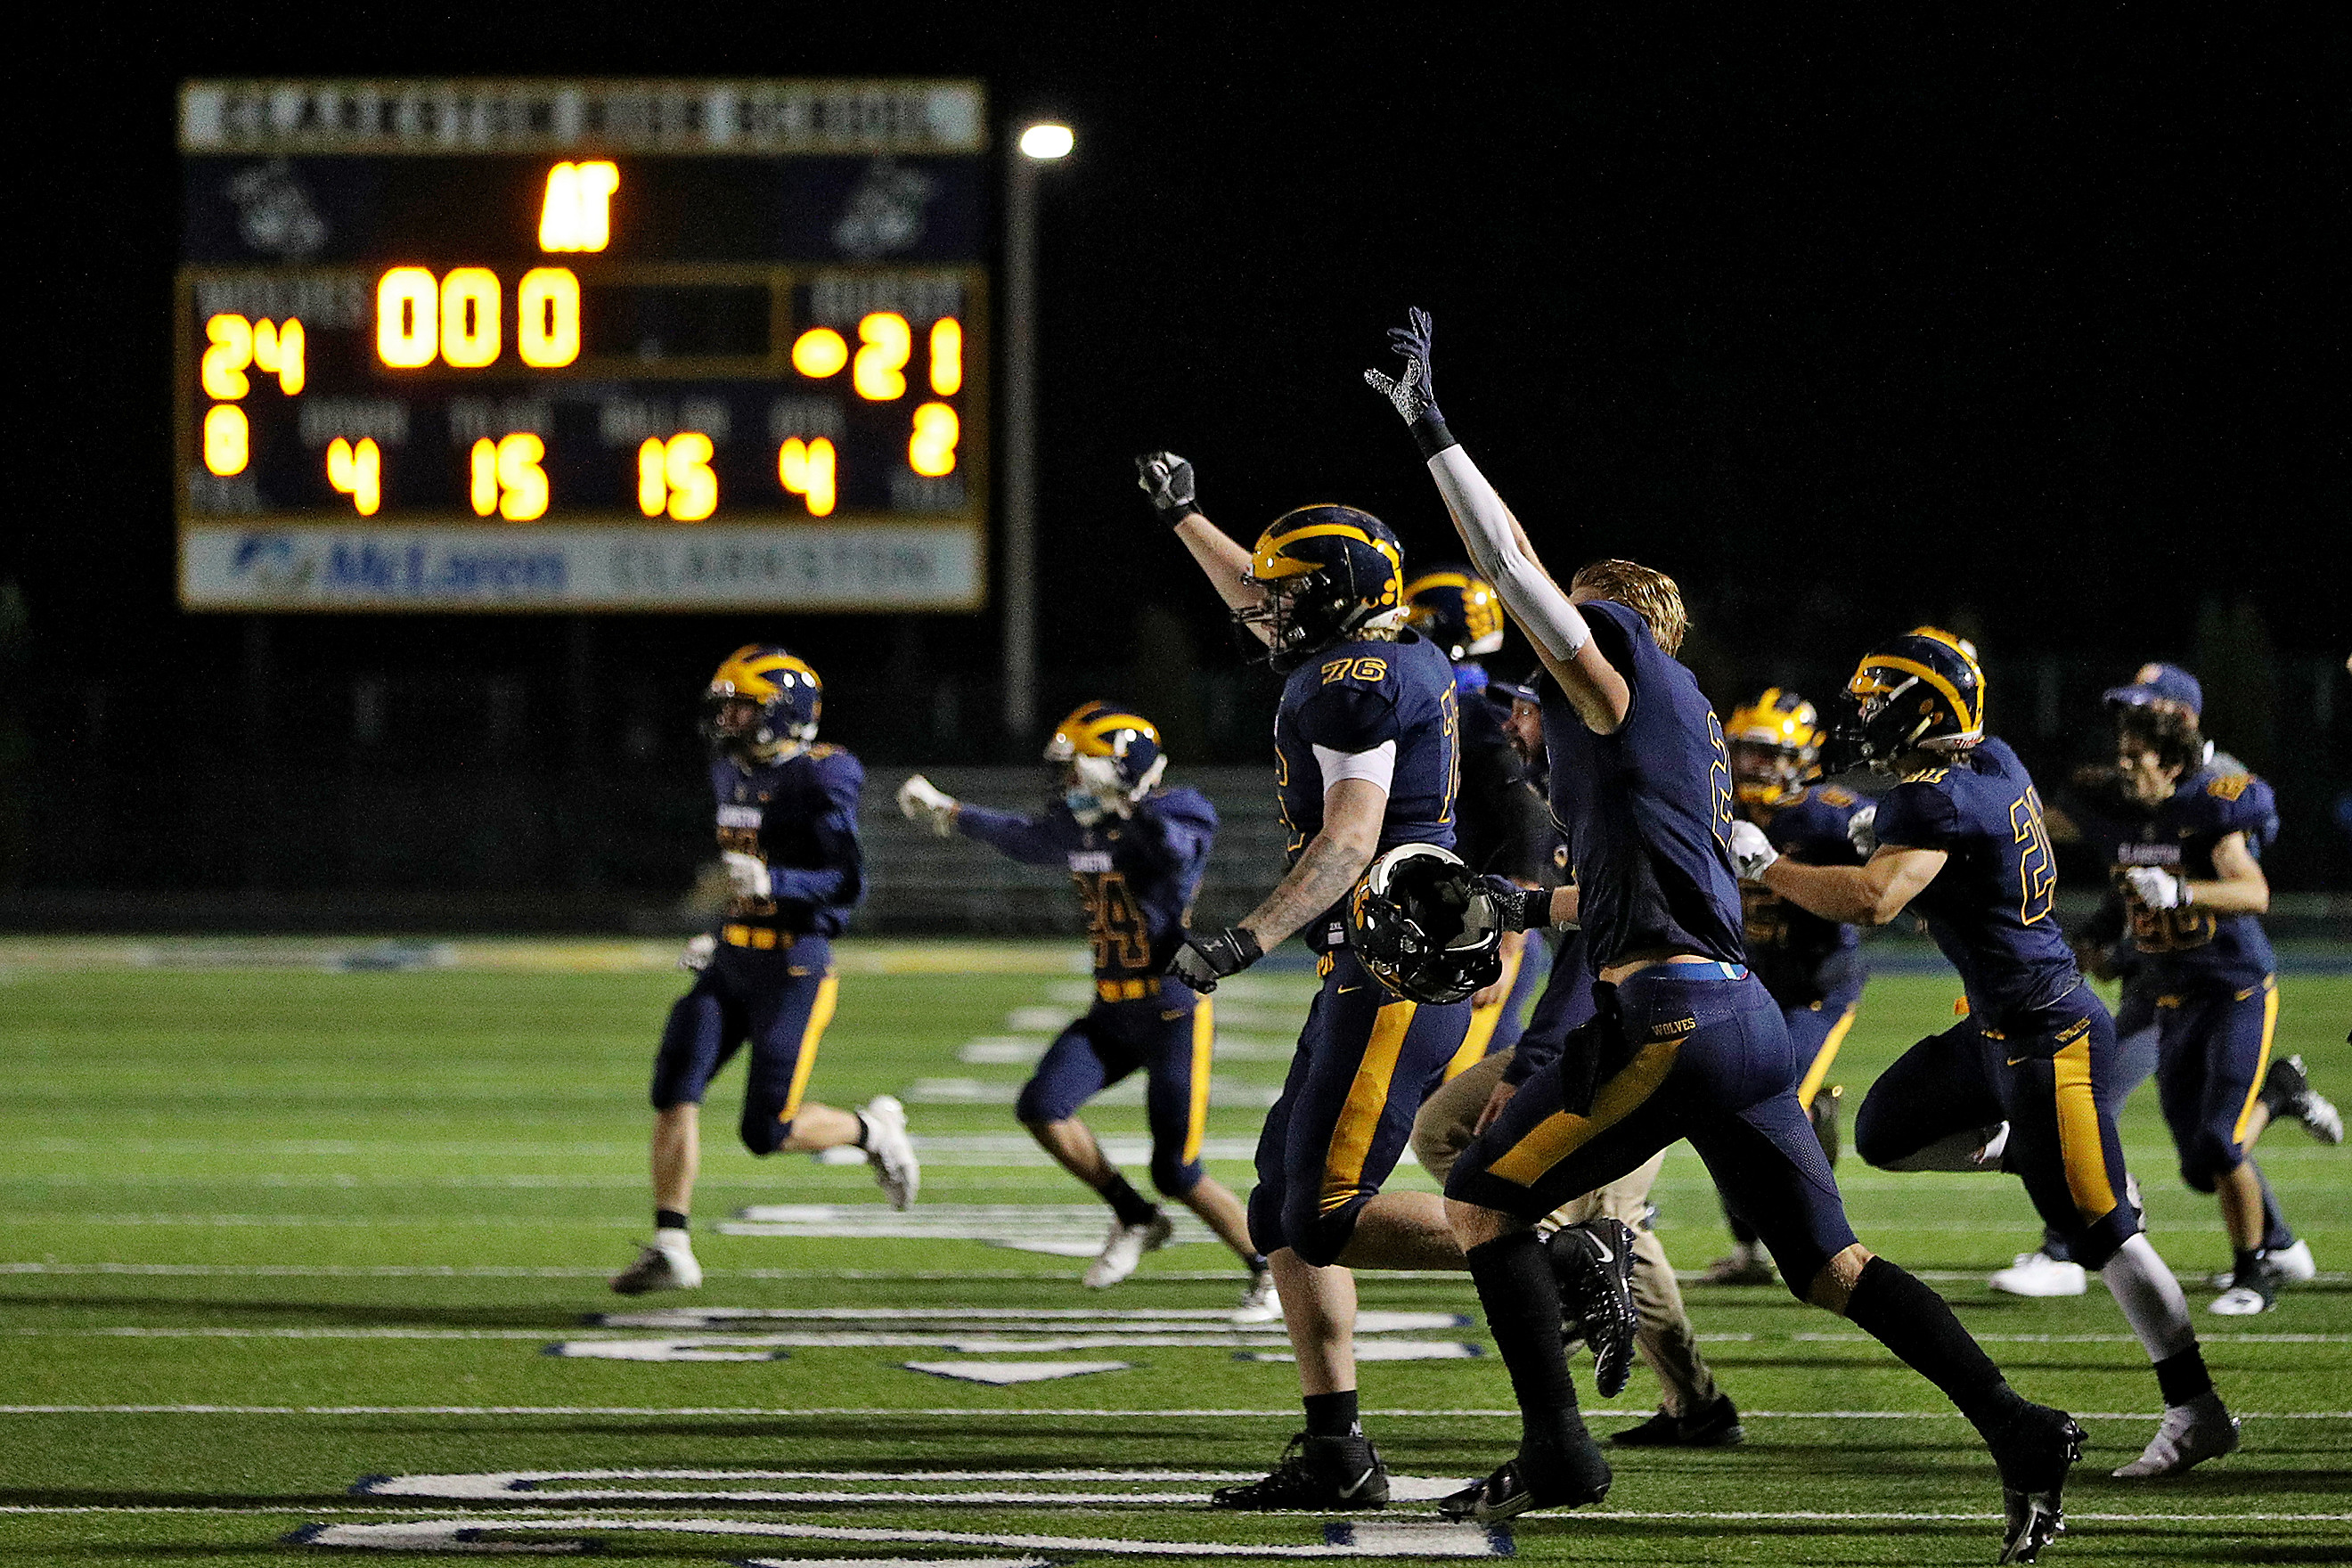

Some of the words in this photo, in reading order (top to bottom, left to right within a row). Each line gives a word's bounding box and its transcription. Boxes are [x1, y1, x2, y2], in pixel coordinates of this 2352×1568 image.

[202, 314, 305, 400] 24
[328, 437, 380, 516] 4
[471, 433, 549, 521] 15
[639, 433, 717, 521] 15
[780, 437, 836, 517] 4
[1321, 657, 1388, 686] 76
[1651, 1017, 1696, 1036] WOLVES
